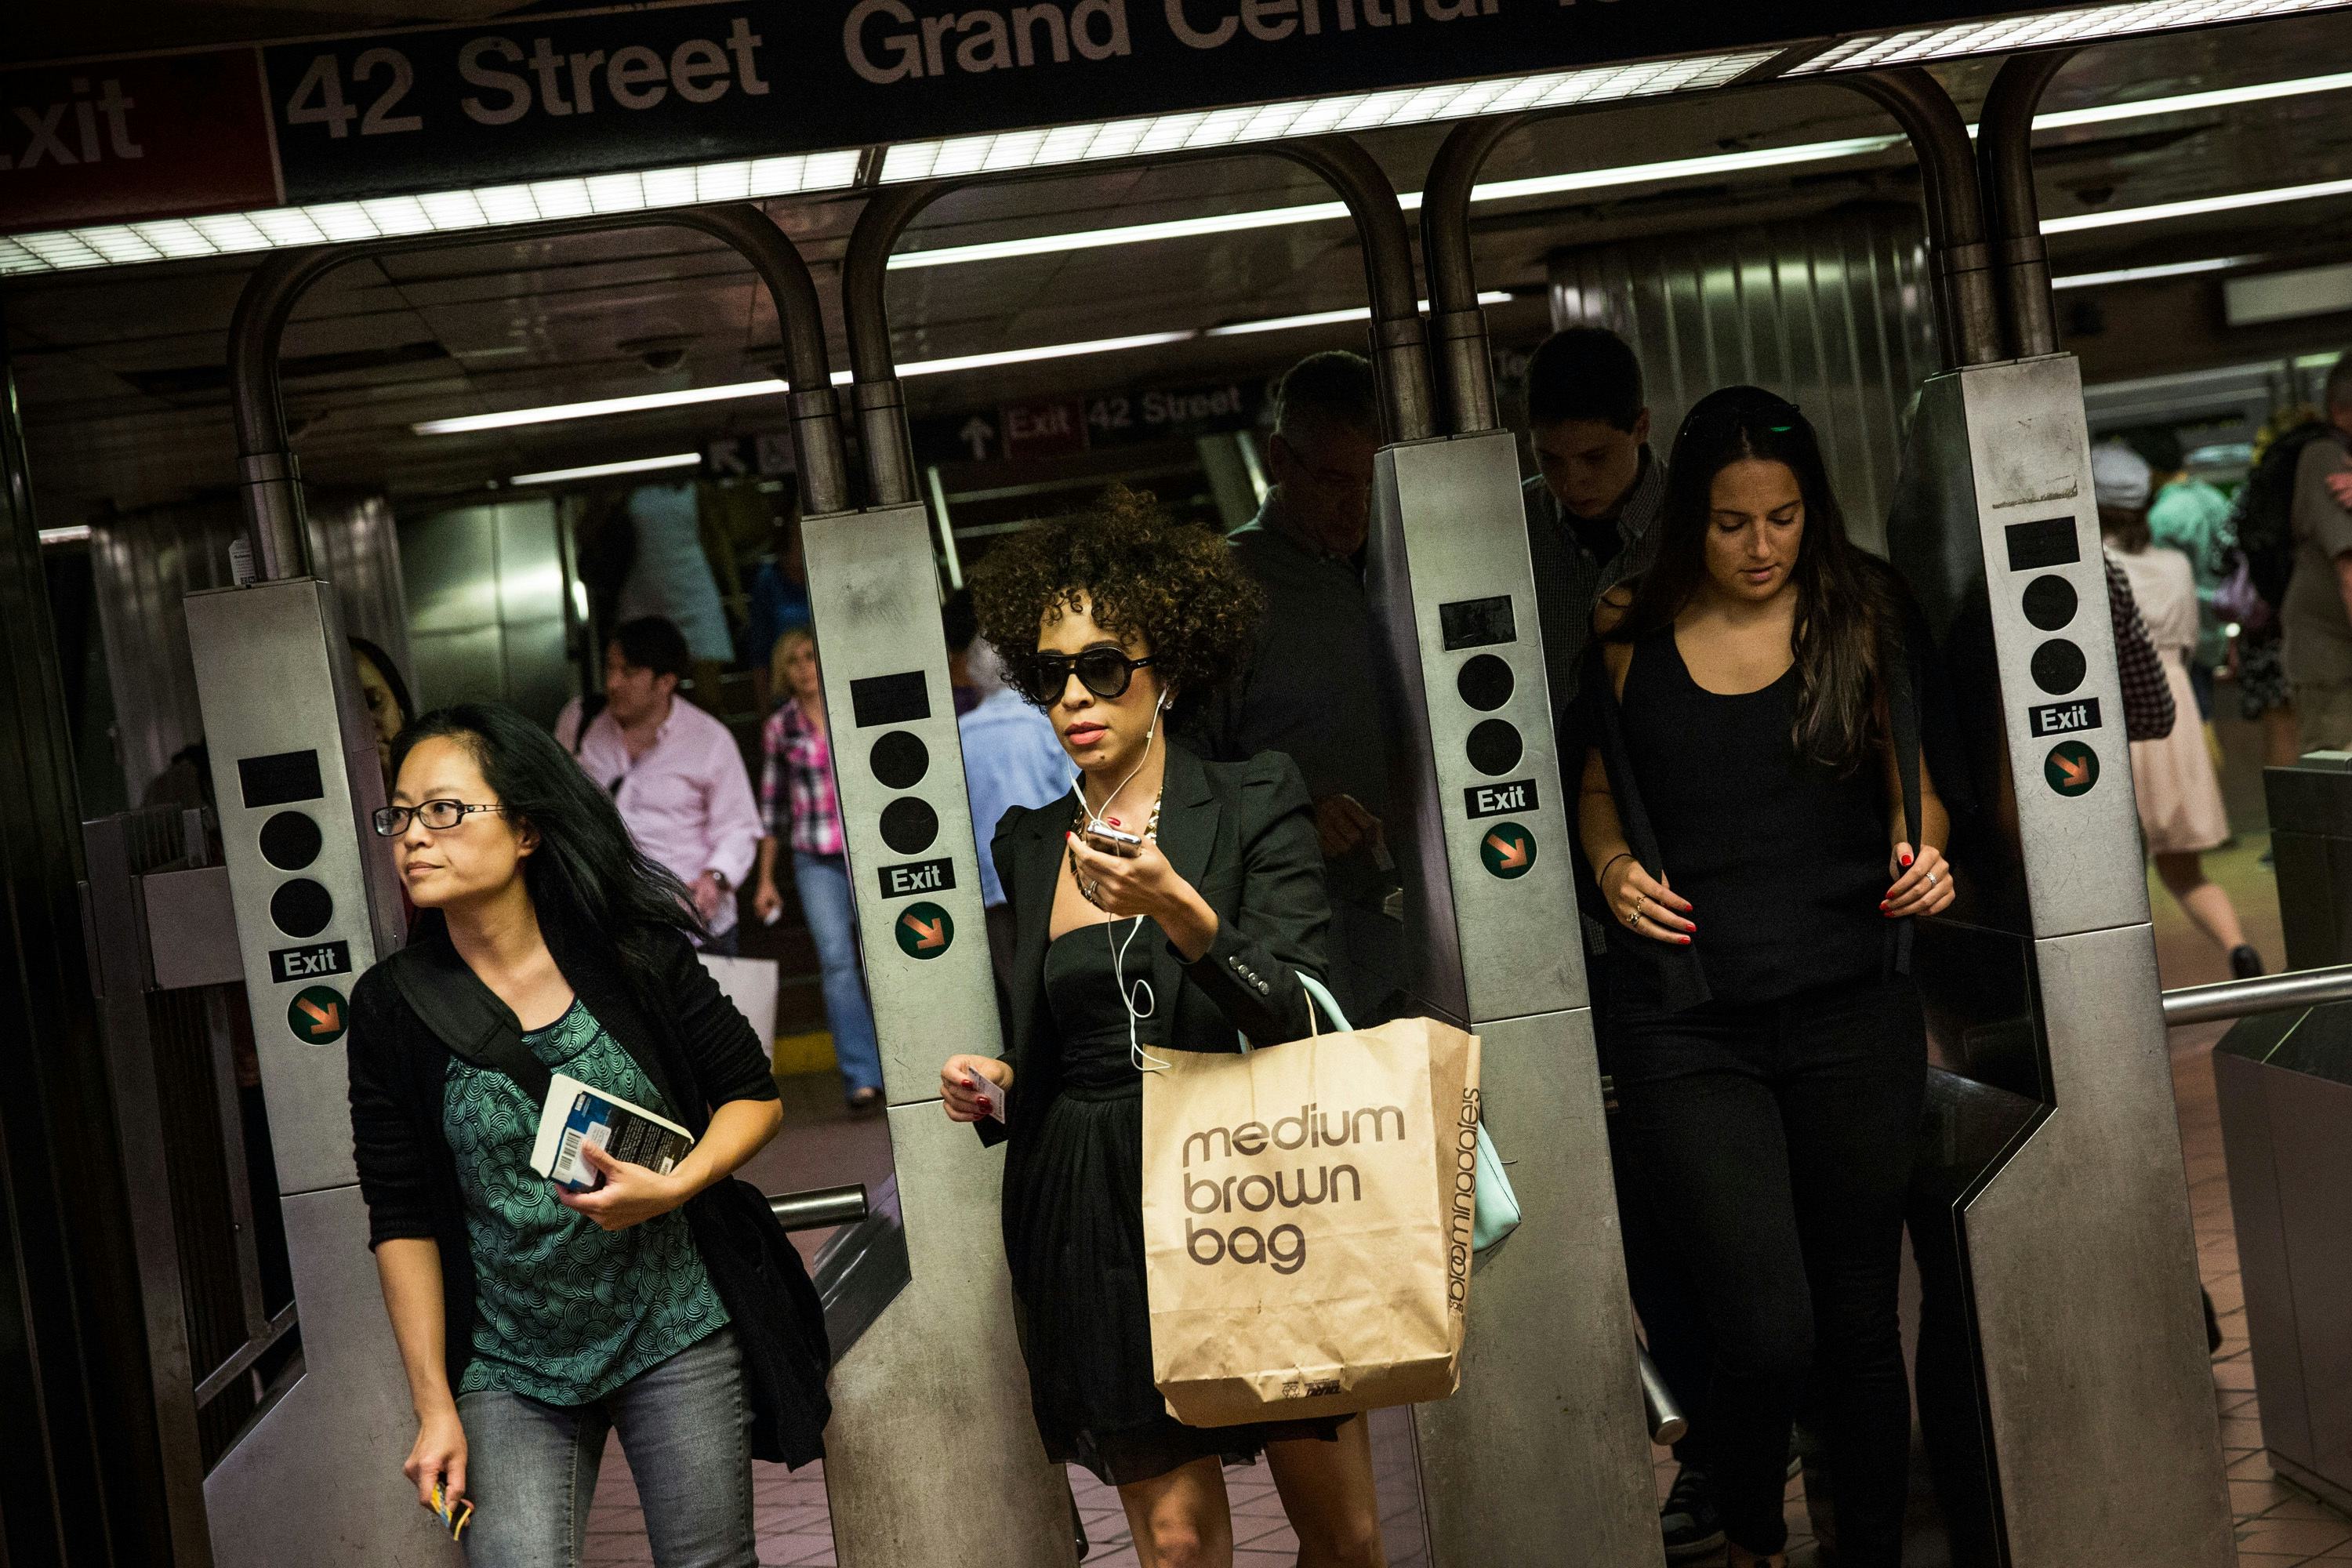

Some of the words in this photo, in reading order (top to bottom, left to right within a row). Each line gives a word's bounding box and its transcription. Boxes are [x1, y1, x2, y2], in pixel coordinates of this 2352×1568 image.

[285, 47, 425, 139] 42
[457, 16, 771, 125] Street
[842, 0, 1132, 85] Grand
[0, 78, 143, 171] xit
[1008, 402, 1071, 439] Exit
[1090, 396, 1132, 430] 42
[1143, 385, 1242, 423] Street
[2040, 705, 2089, 732] Exit
[1477, 785, 1526, 813] Exit
[891, 865, 942, 892] Exit
[283, 948, 337, 977] Exit
[1182, 1102, 1406, 1168] medium
[1183, 1163, 1362, 1214] brown
[1185, 1217, 1307, 1276] bag
